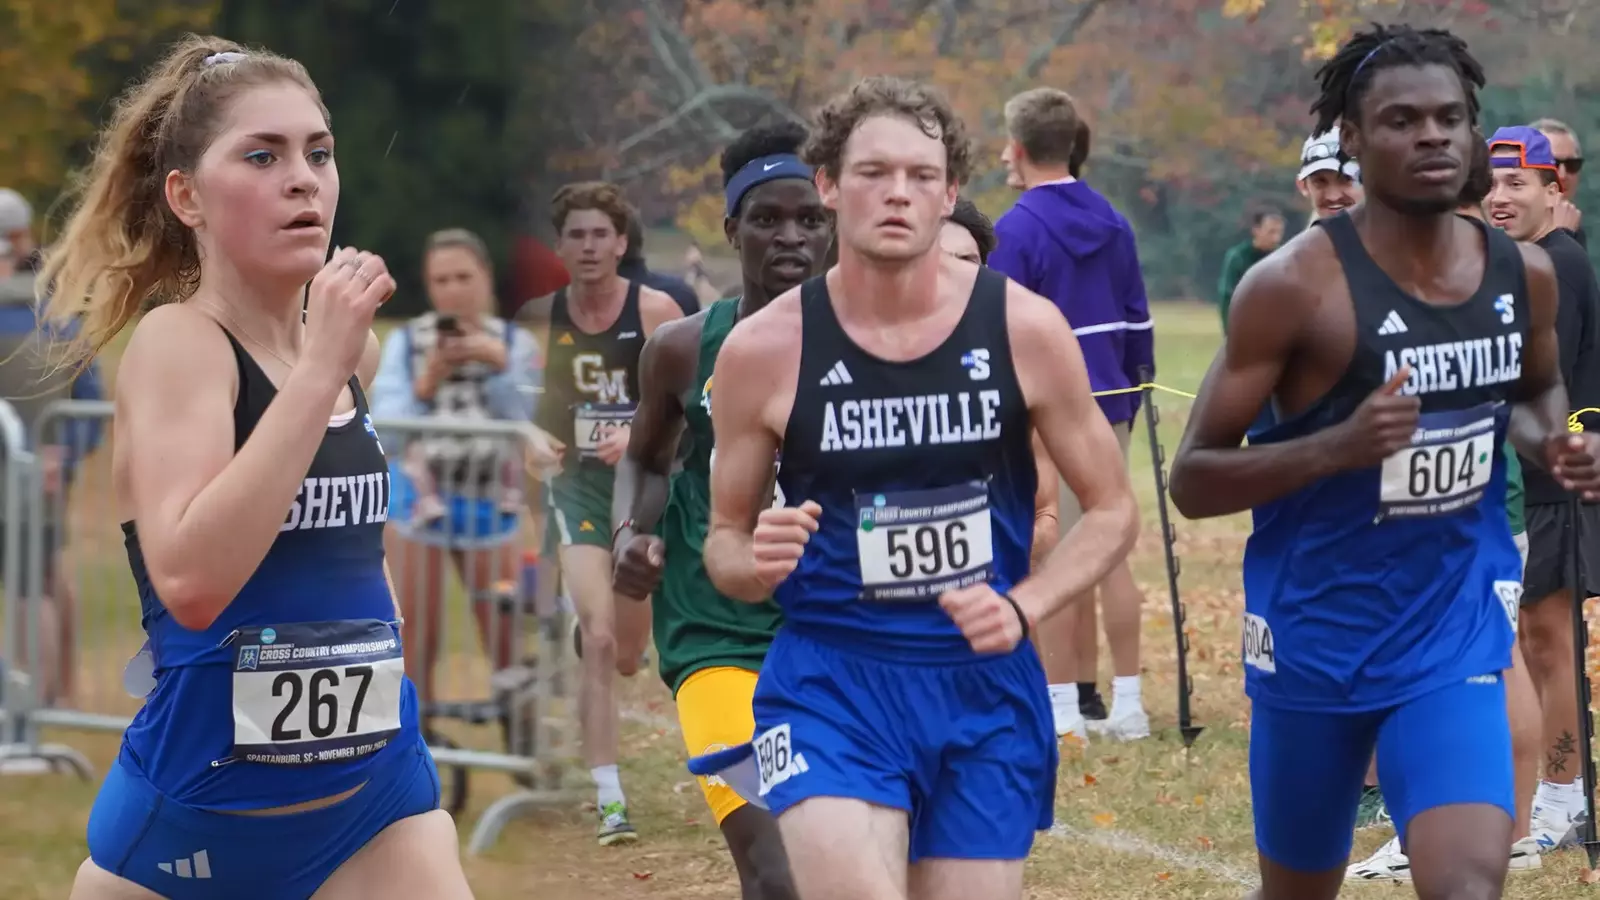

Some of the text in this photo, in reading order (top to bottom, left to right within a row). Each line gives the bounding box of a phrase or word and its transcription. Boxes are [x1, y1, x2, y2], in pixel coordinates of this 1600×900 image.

[1384, 332, 1522, 396] ASHEVILLE
[820, 389, 1002, 451] ASHEVILLE
[1408, 440, 1475, 498] 604
[279, 472, 391, 532] SHEVIL
[887, 519, 970, 578] 596
[260, 649, 291, 661] CROSS
[292, 645, 330, 659] COUNTRY
[331, 638, 396, 655] CHAMPIONSHIPS
[1244, 616, 1273, 663] 604
[271, 665, 374, 742] 267
[303, 754, 314, 763] SC
[319, 750, 355, 761] NOVEMBER
[758, 731, 788, 784] 596
